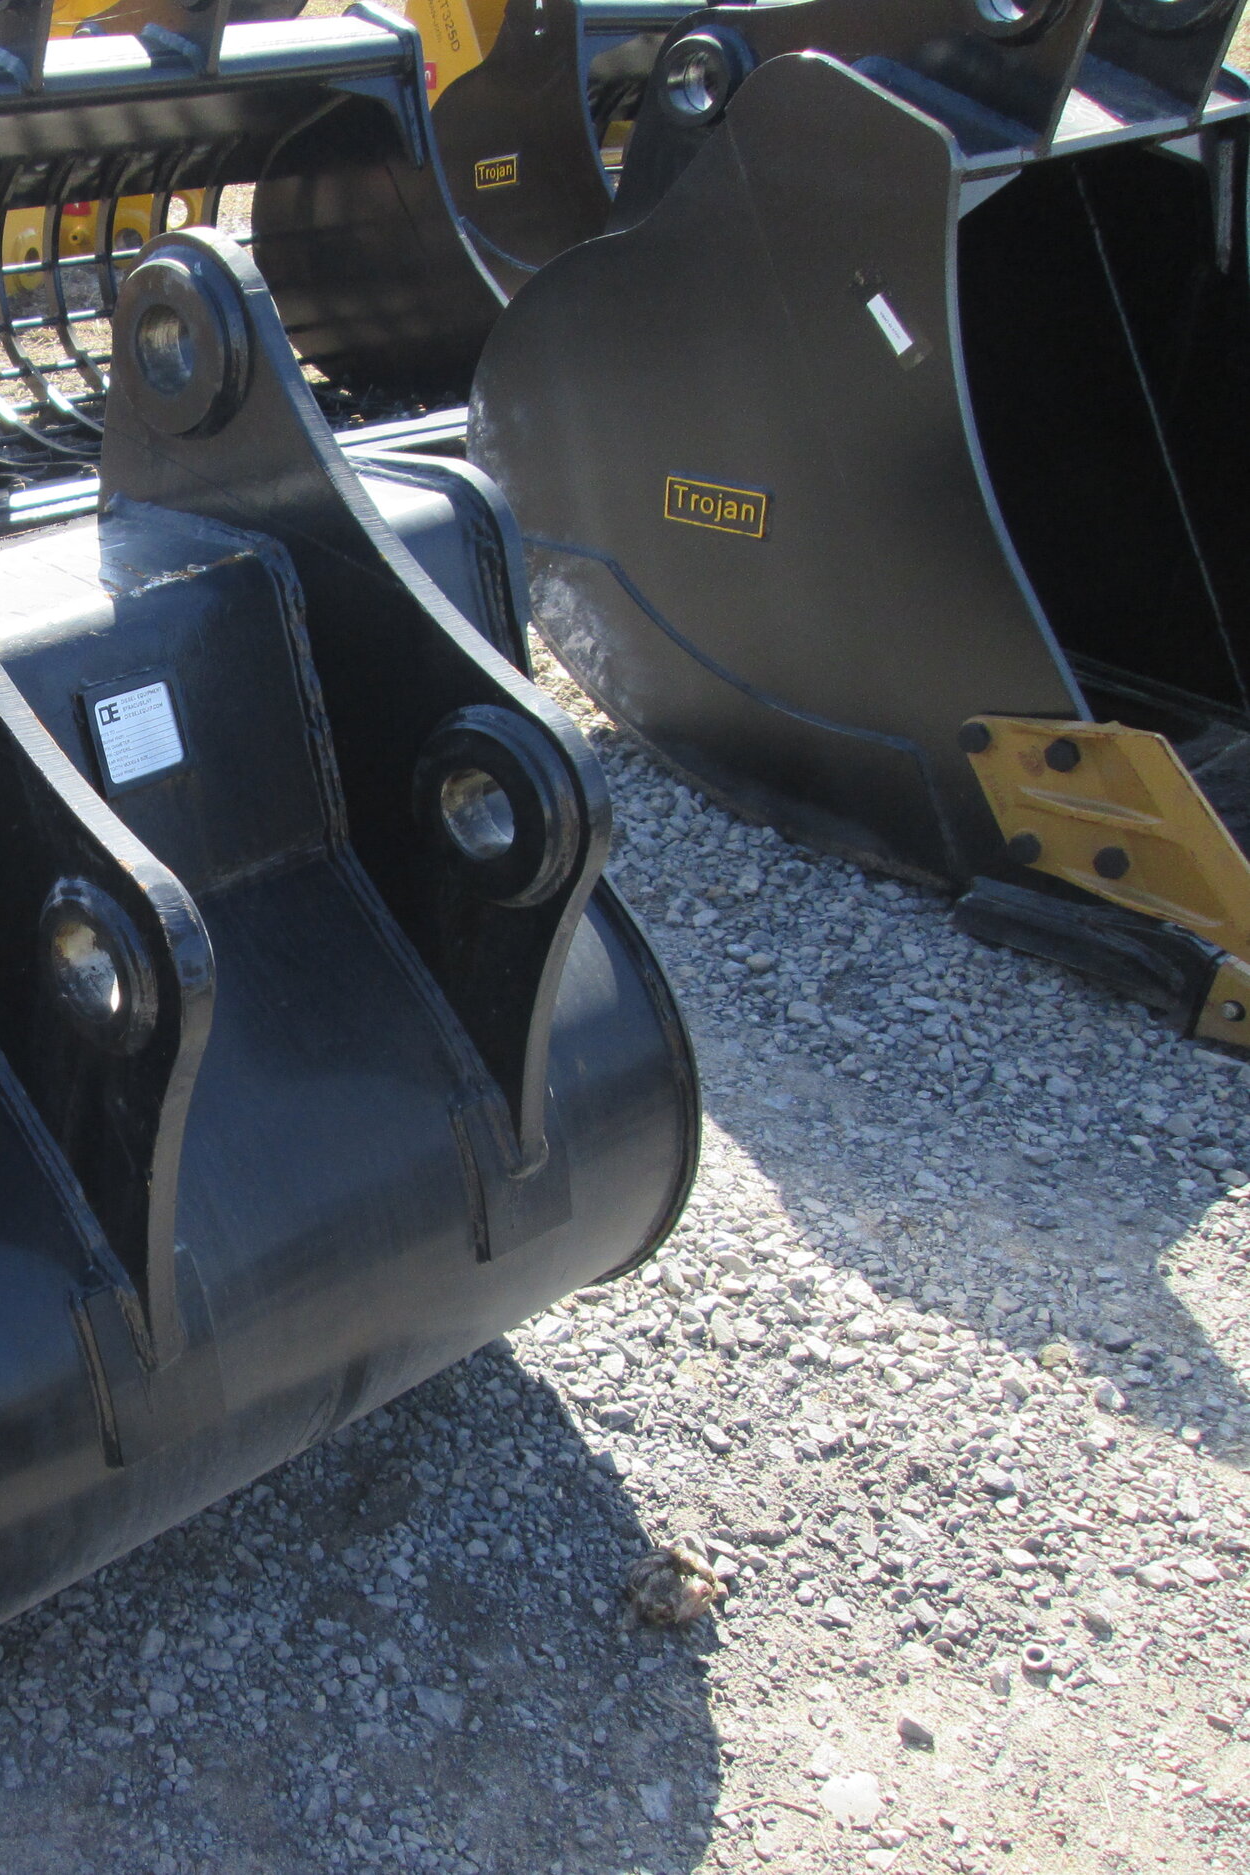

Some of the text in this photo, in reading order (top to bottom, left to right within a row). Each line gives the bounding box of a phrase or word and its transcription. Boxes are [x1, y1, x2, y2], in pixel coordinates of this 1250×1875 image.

[478, 163, 512, 181] Trojan
[673, 484, 755, 523] Trojan
[98, 702, 121, 726] DE
